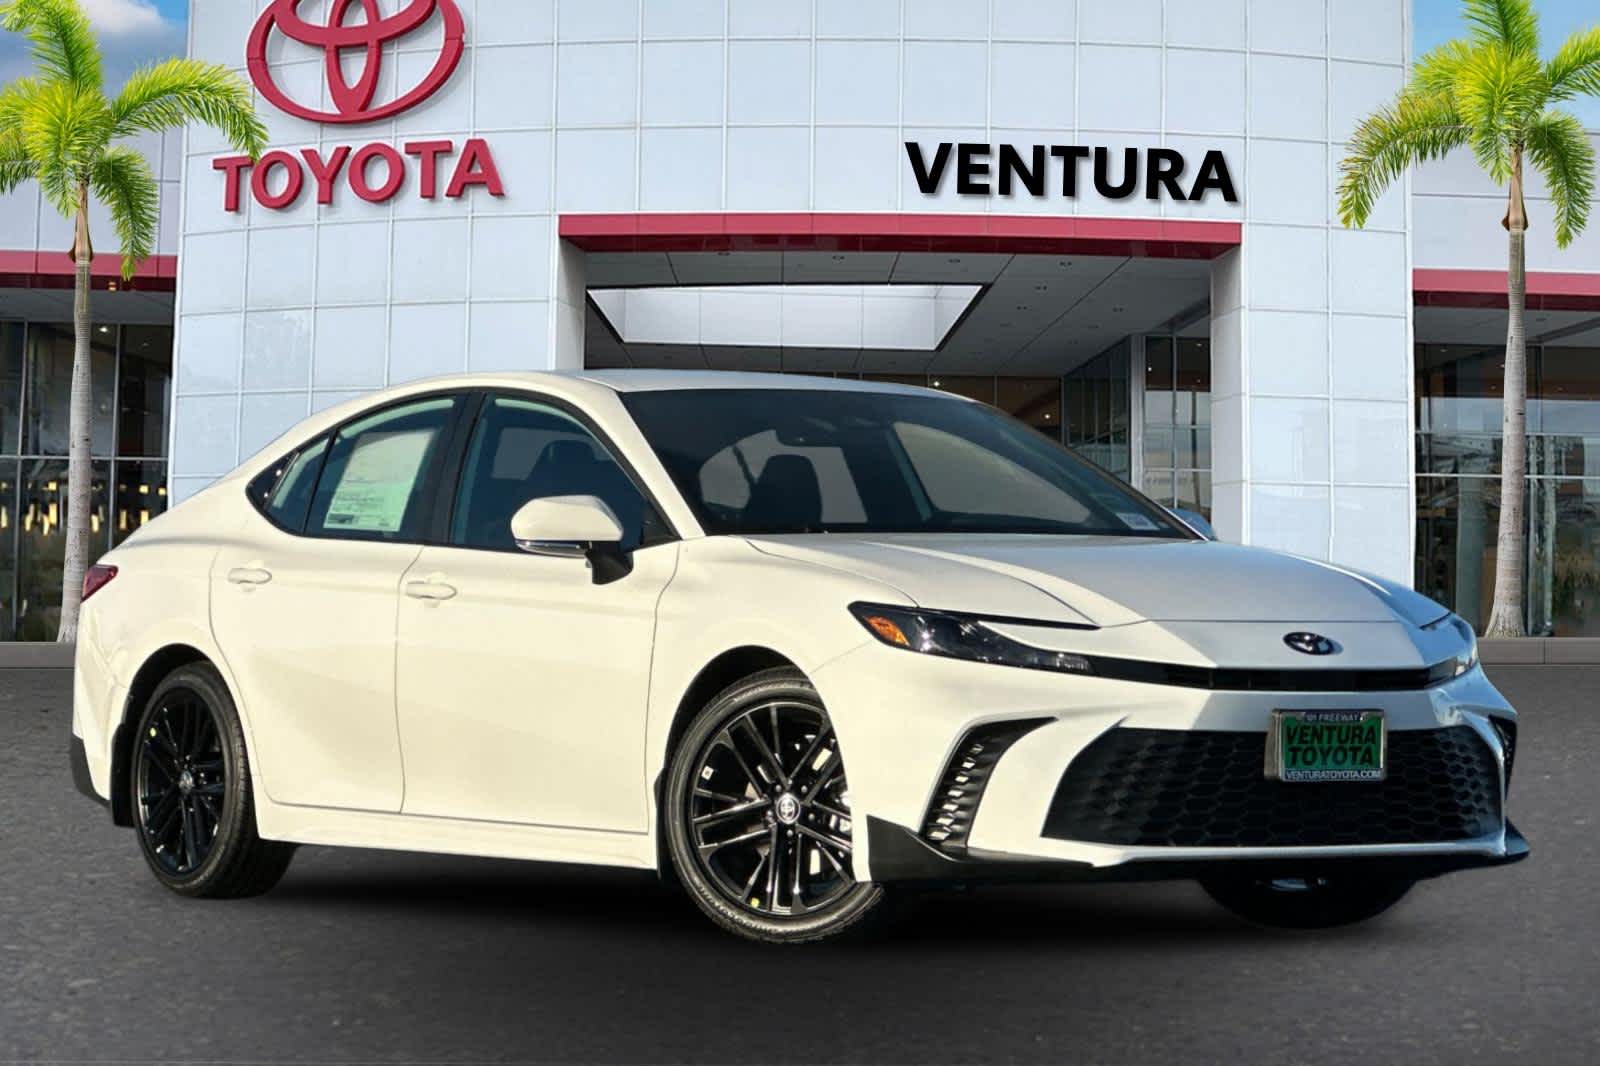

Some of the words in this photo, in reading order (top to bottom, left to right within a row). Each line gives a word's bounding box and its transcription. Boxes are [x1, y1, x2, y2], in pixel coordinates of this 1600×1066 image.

[212, 138, 505, 212] TOYOTA
[905, 141, 1238, 203] VENTURA
[1286, 724, 1376, 745] VENTURA
[1287, 746, 1375, 766] TOYOTA
[1285, 769, 1381, 780] VENTURATOYOTA.COM
